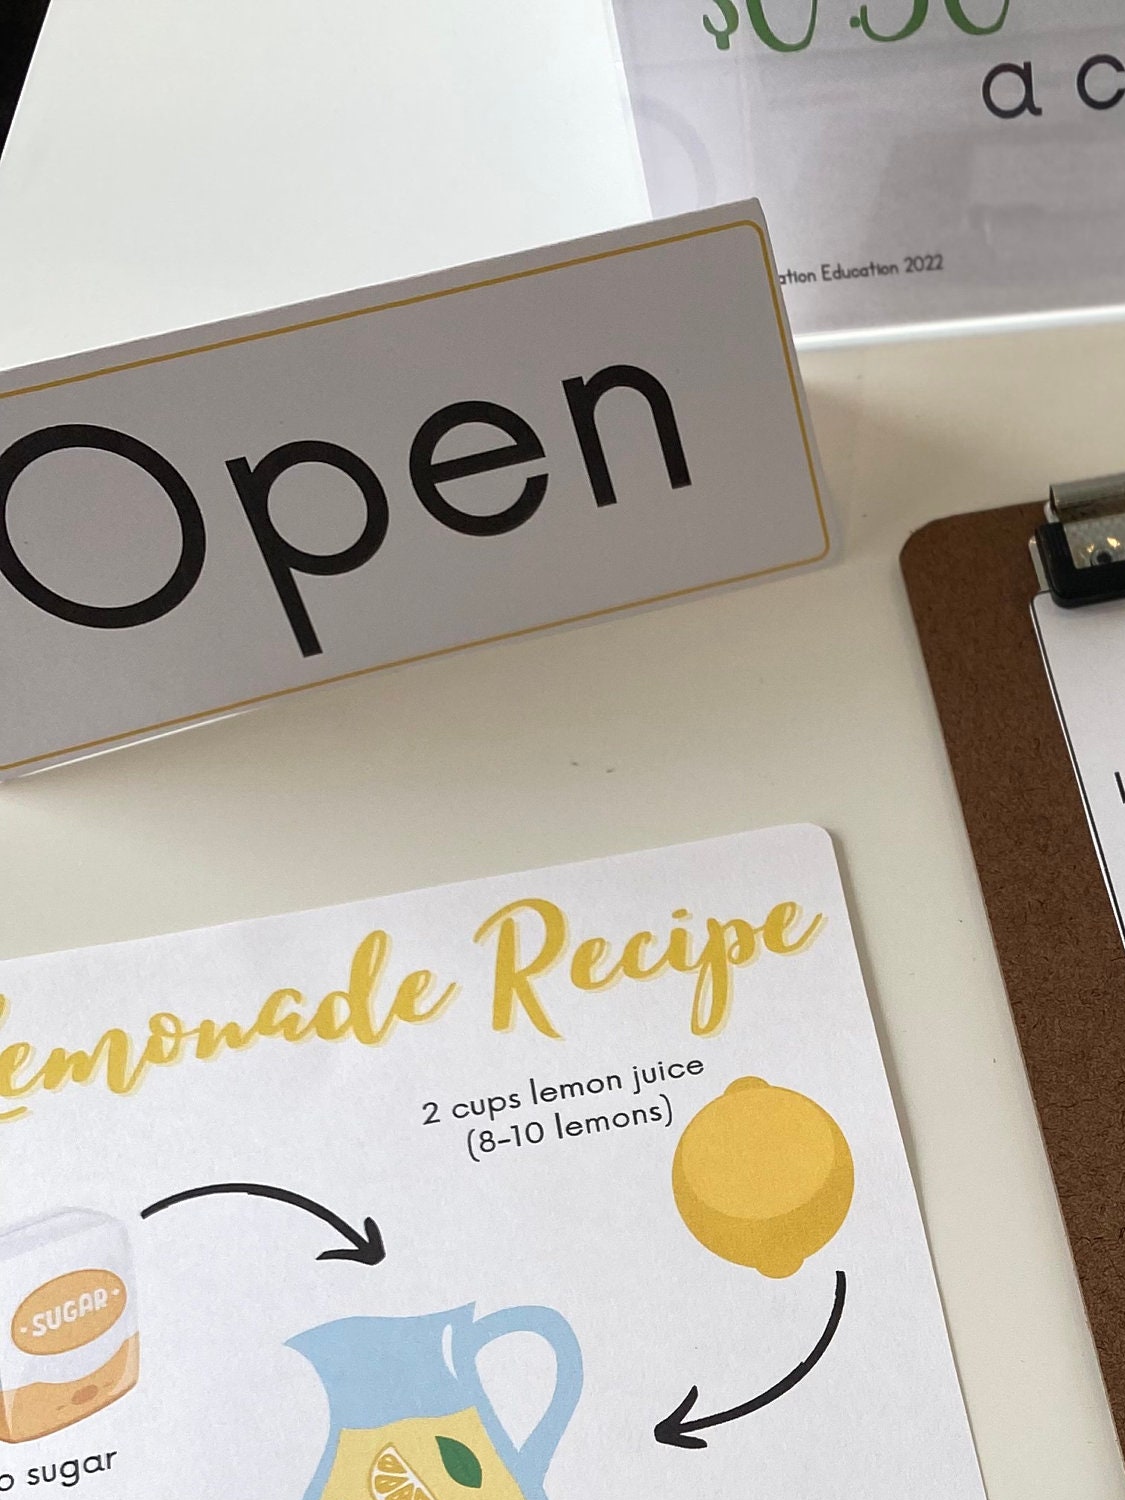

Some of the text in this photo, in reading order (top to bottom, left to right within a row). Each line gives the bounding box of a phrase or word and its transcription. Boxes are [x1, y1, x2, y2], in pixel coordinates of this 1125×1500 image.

[981, 61, 1043, 119] a
[821, 262, 899, 281] Education
[904, 254, 944, 273] 2022
[0, 363, 693, 657] Open
[0, 898, 823, 1121] emonade Recipe
[421, 1057, 705, 1132] 2 cups lemon juice
[555, 1092, 675, 1142] lemons)
[31, 1287, 109, 1338] SUGAR
[26, 1450, 118, 1488] sugar
